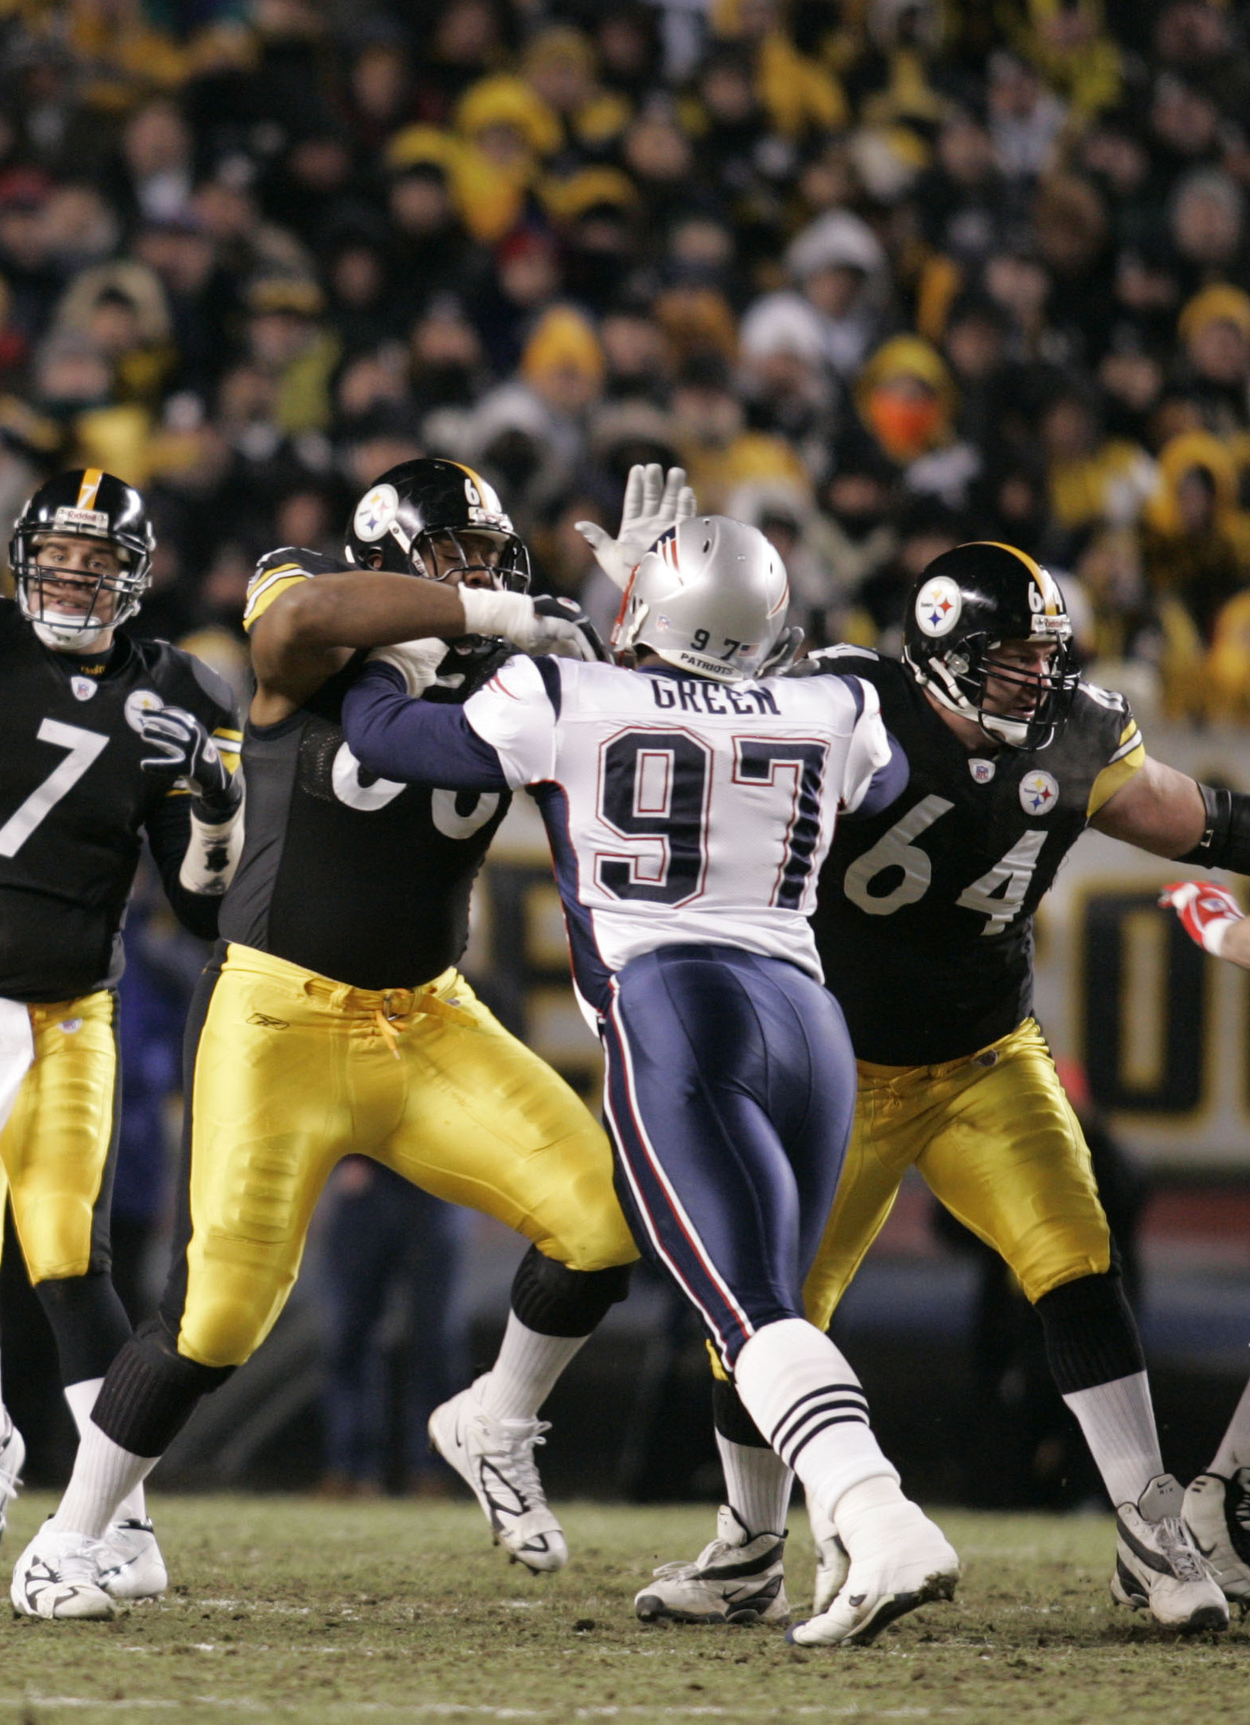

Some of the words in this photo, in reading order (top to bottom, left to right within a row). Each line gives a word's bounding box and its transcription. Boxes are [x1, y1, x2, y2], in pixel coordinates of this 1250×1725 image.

[690, 628, 741, 661] 97
[680, 652, 735, 676] PATRIOTS
[652, 679, 782, 716] GREEN
[594, 726, 831, 909] 97
[844, 794, 1049, 936] 64
